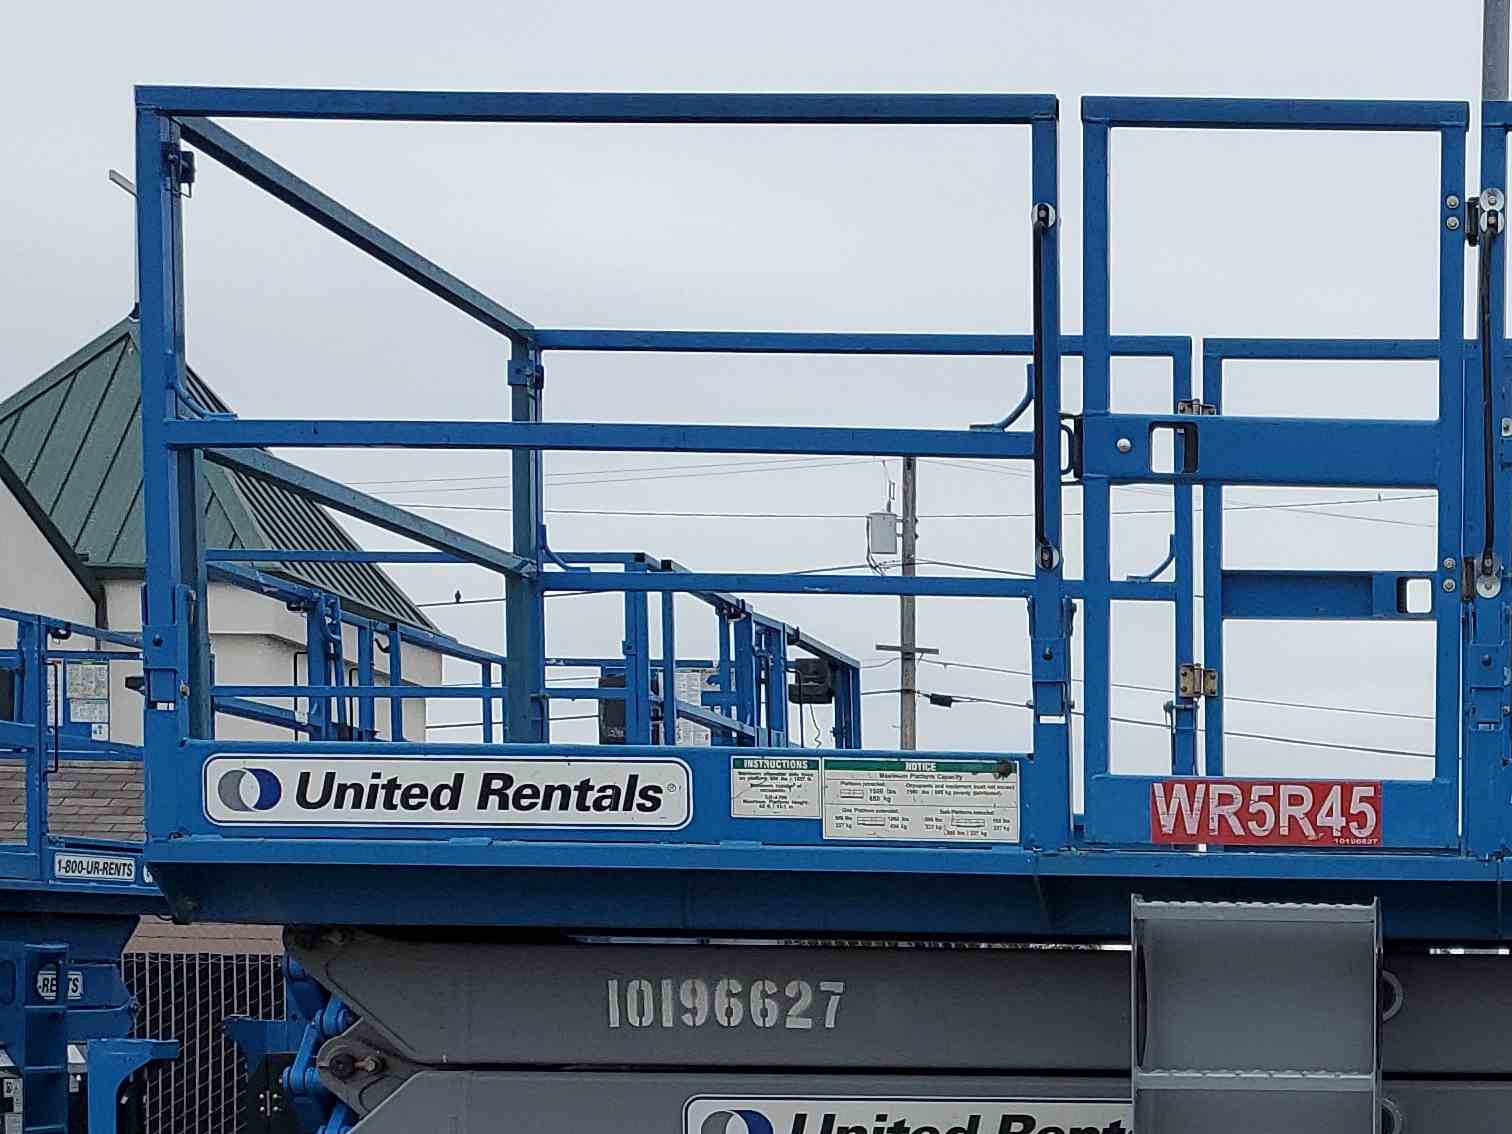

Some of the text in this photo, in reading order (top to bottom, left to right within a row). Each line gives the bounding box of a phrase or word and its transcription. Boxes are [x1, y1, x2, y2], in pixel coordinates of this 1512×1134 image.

[743, 759, 809, 770] INSTRUCTIONS
[904, 761, 937, 772] NOTICE
[295, 771, 663, 813] United Rentals
[1151, 782, 1378, 838] WR5R45
[56, 858, 134, 878] 1-800-UR-RENTS
[607, 979, 845, 1029] 10196627
